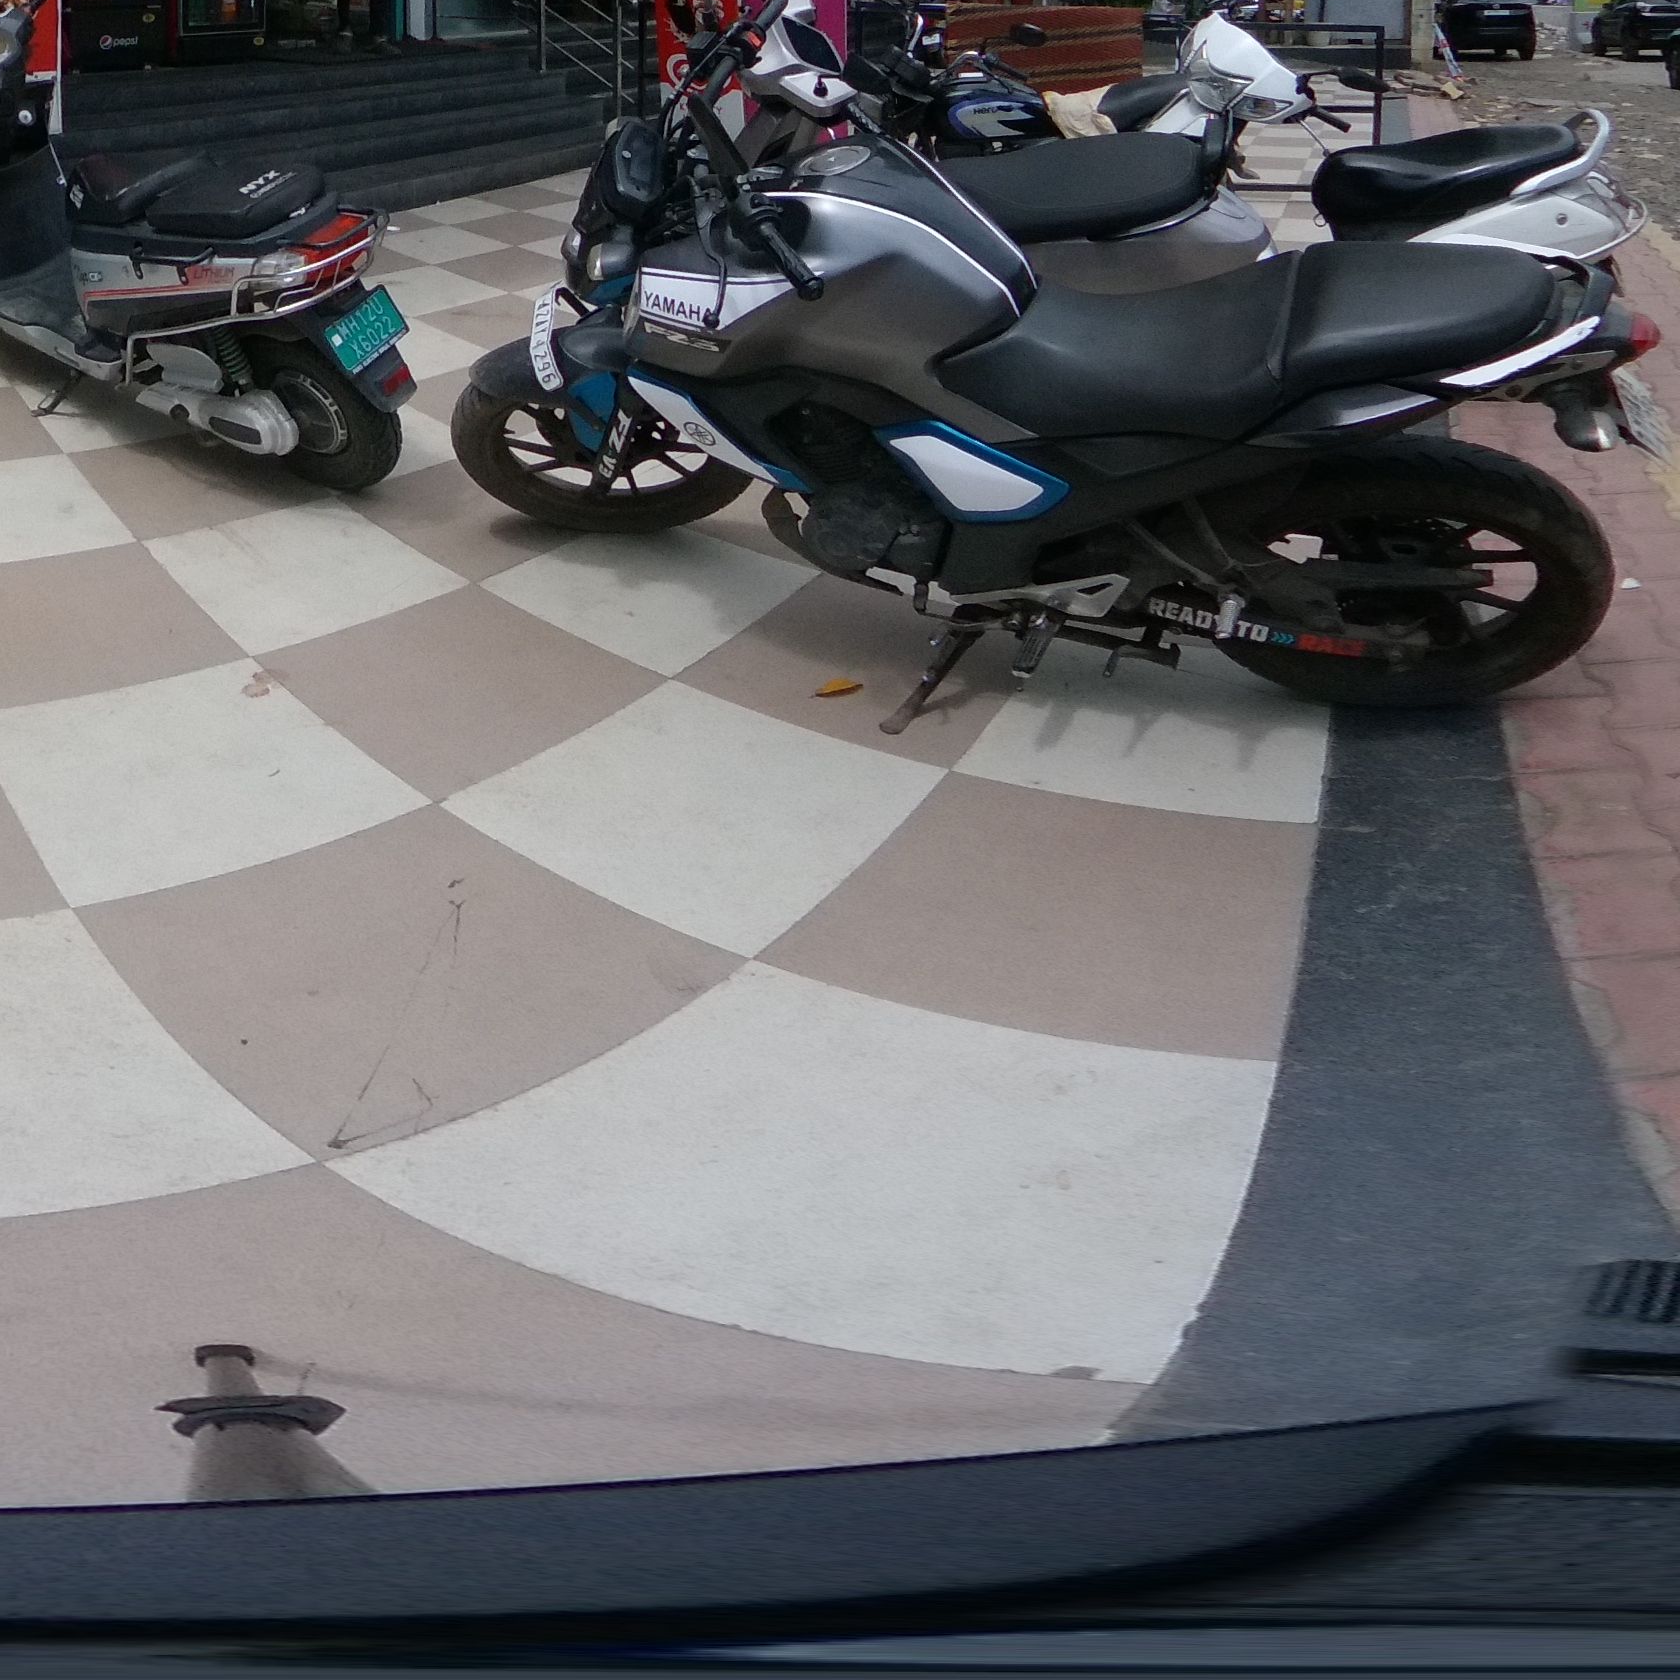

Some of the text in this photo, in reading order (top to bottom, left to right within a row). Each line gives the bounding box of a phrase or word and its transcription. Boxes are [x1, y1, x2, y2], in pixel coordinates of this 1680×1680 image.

[113, 35, 139, 48] pepsi
[239, 170, 281, 194] NYX
[1237, 621, 1270, 642] TO
